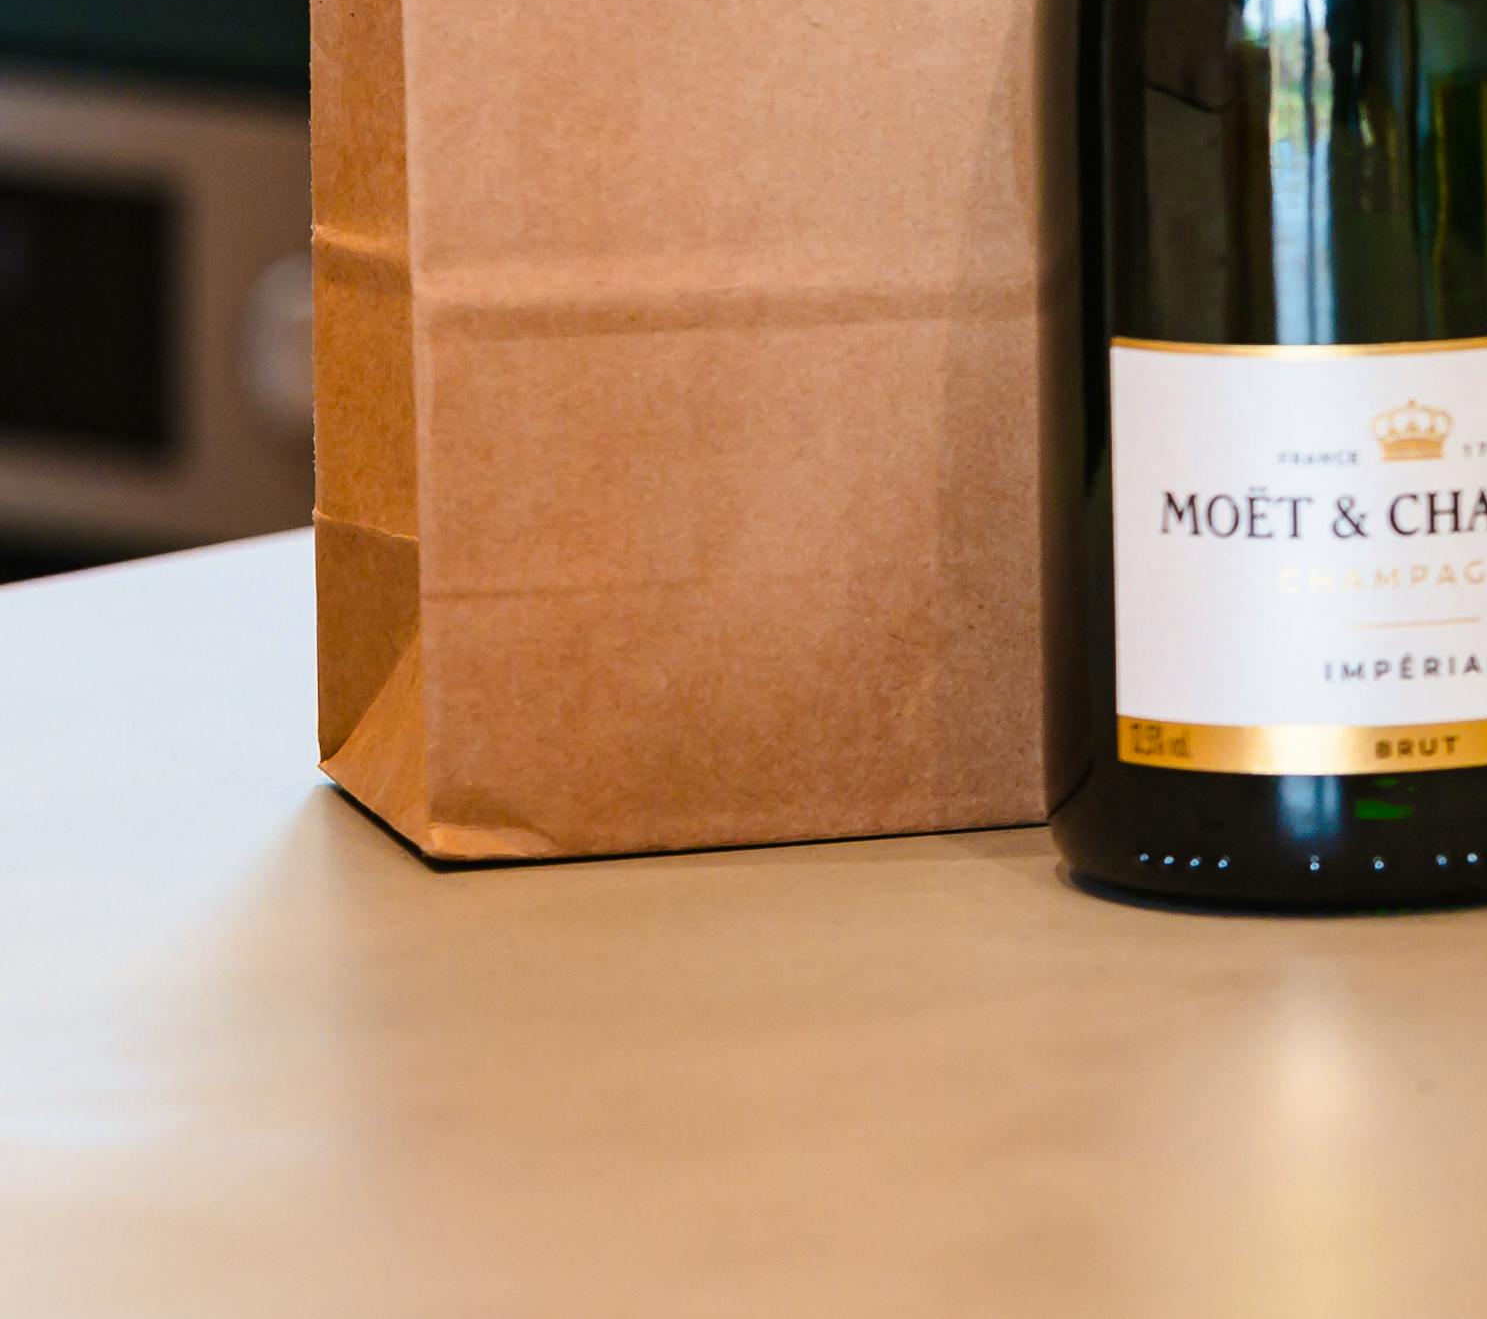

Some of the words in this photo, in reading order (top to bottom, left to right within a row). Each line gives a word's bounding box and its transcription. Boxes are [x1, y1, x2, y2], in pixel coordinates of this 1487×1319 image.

[1160, 485, 1315, 540] MOËT
[1332, 495, 1369, 539] &
[1375, 735, 1460, 760] BRUT
